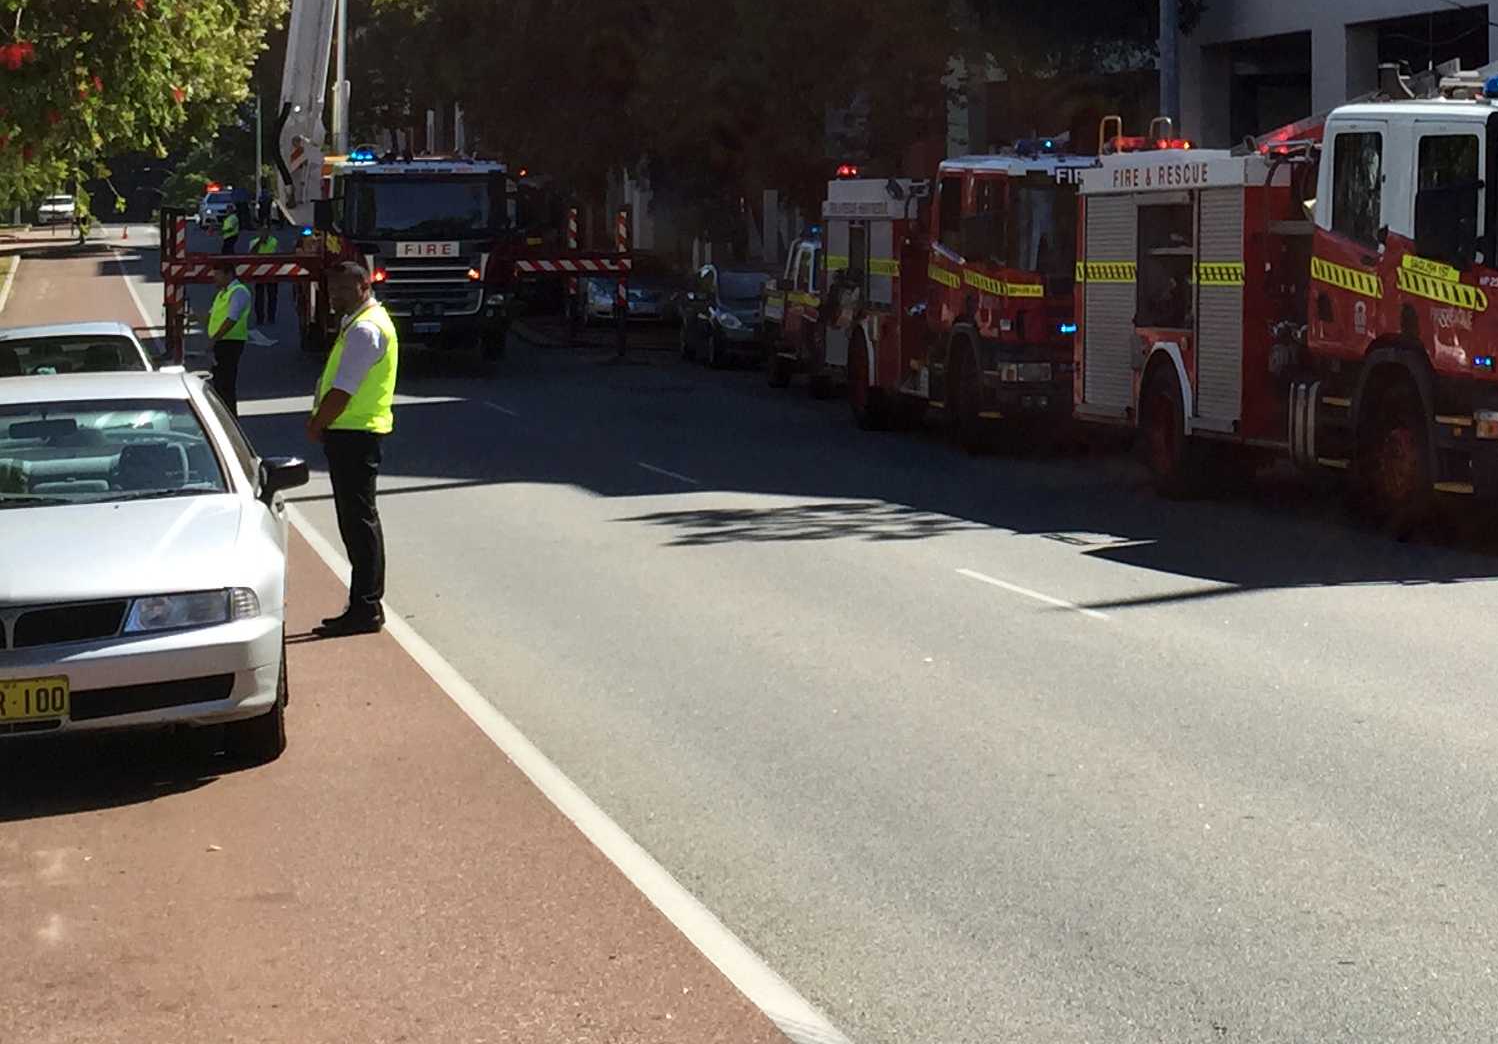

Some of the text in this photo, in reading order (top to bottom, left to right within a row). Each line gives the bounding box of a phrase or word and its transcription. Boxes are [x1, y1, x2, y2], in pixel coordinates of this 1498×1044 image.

[1113, 163, 1209, 187] FIRE & RESCUE
[404, 243, 452, 256] FIRE
